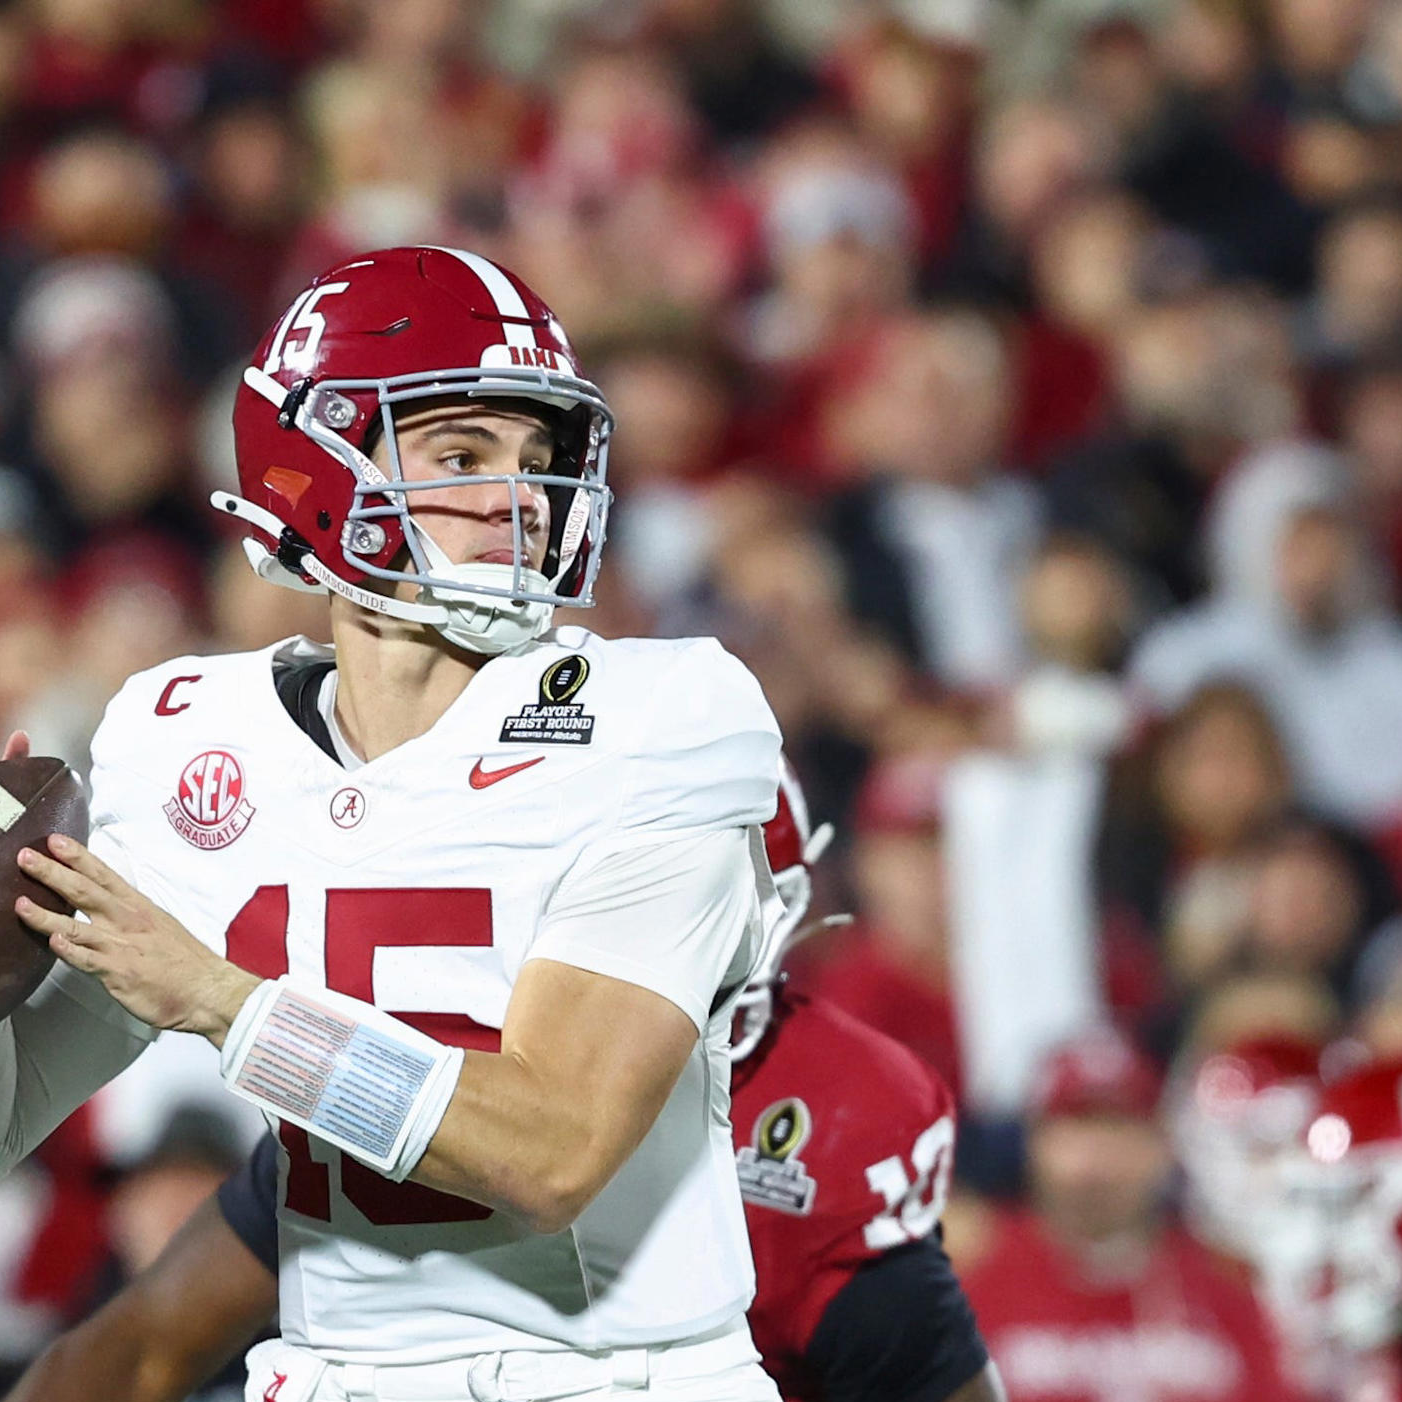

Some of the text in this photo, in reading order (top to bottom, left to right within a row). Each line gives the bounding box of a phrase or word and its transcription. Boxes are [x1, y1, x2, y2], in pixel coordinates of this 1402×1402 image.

[263, 282, 350, 376] 15
[508, 346, 559, 370] BAMA
[306, 555, 388, 612] CRIMSON TIDE
[154, 674, 203, 717] C
[522, 706, 581, 717] PLAYOFF
[505, 718, 592, 729] FIRST ROUND
[181, 752, 242, 824] SEC
[174, 815, 241, 848] GRADUATE
